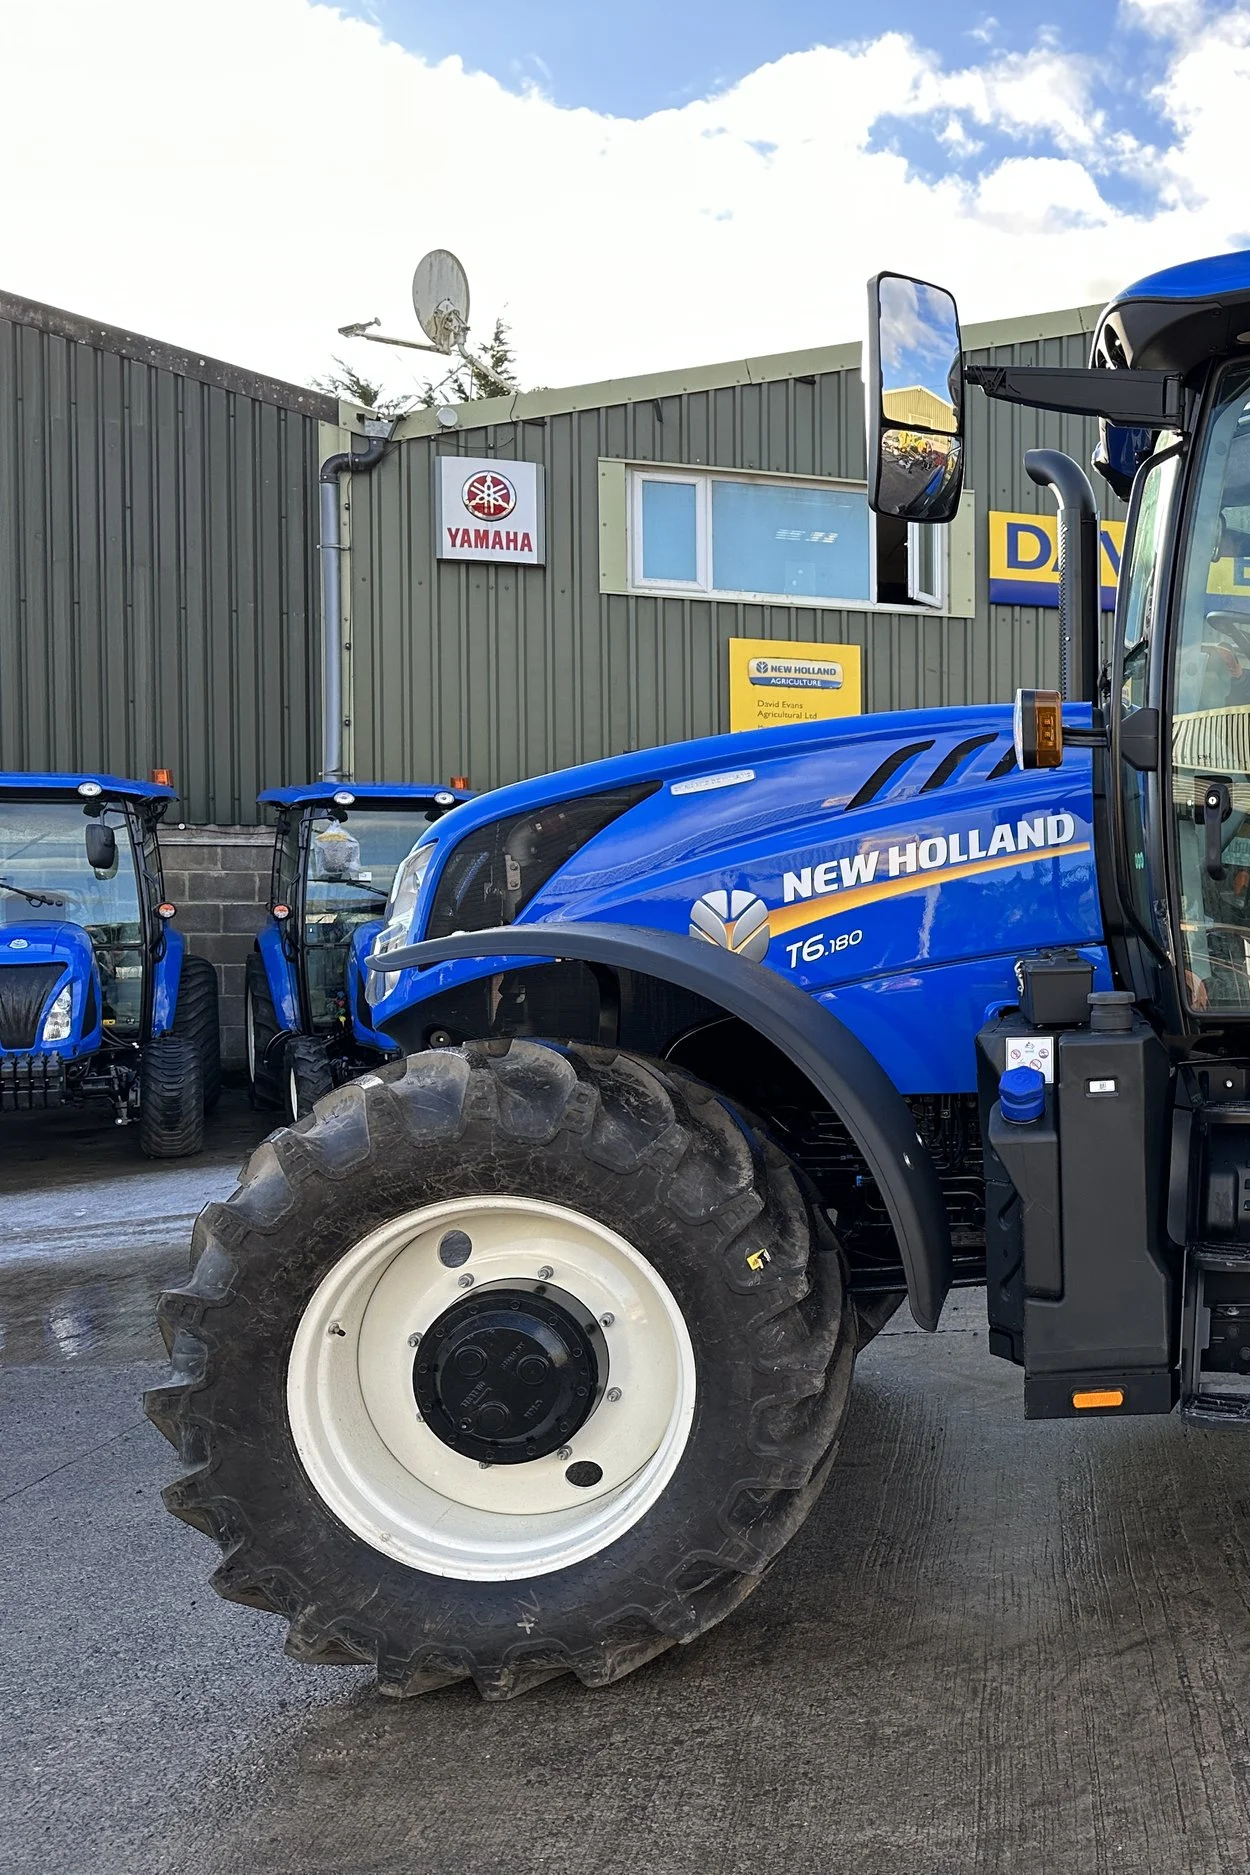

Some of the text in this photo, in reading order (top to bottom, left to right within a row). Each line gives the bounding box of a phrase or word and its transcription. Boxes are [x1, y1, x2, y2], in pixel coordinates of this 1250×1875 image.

[447, 527, 533, 552] YAMAHA
[770, 664, 837, 676] NEW HOLLAND
[770, 678, 822, 687] AGRICULTURE
[757, 700, 803, 709] David Evans
[757, 710, 817, 720] Agricultural Ltd
[783, 813, 1076, 903] NEW HOLLAND
[786, 929, 864, 969] T6.180
